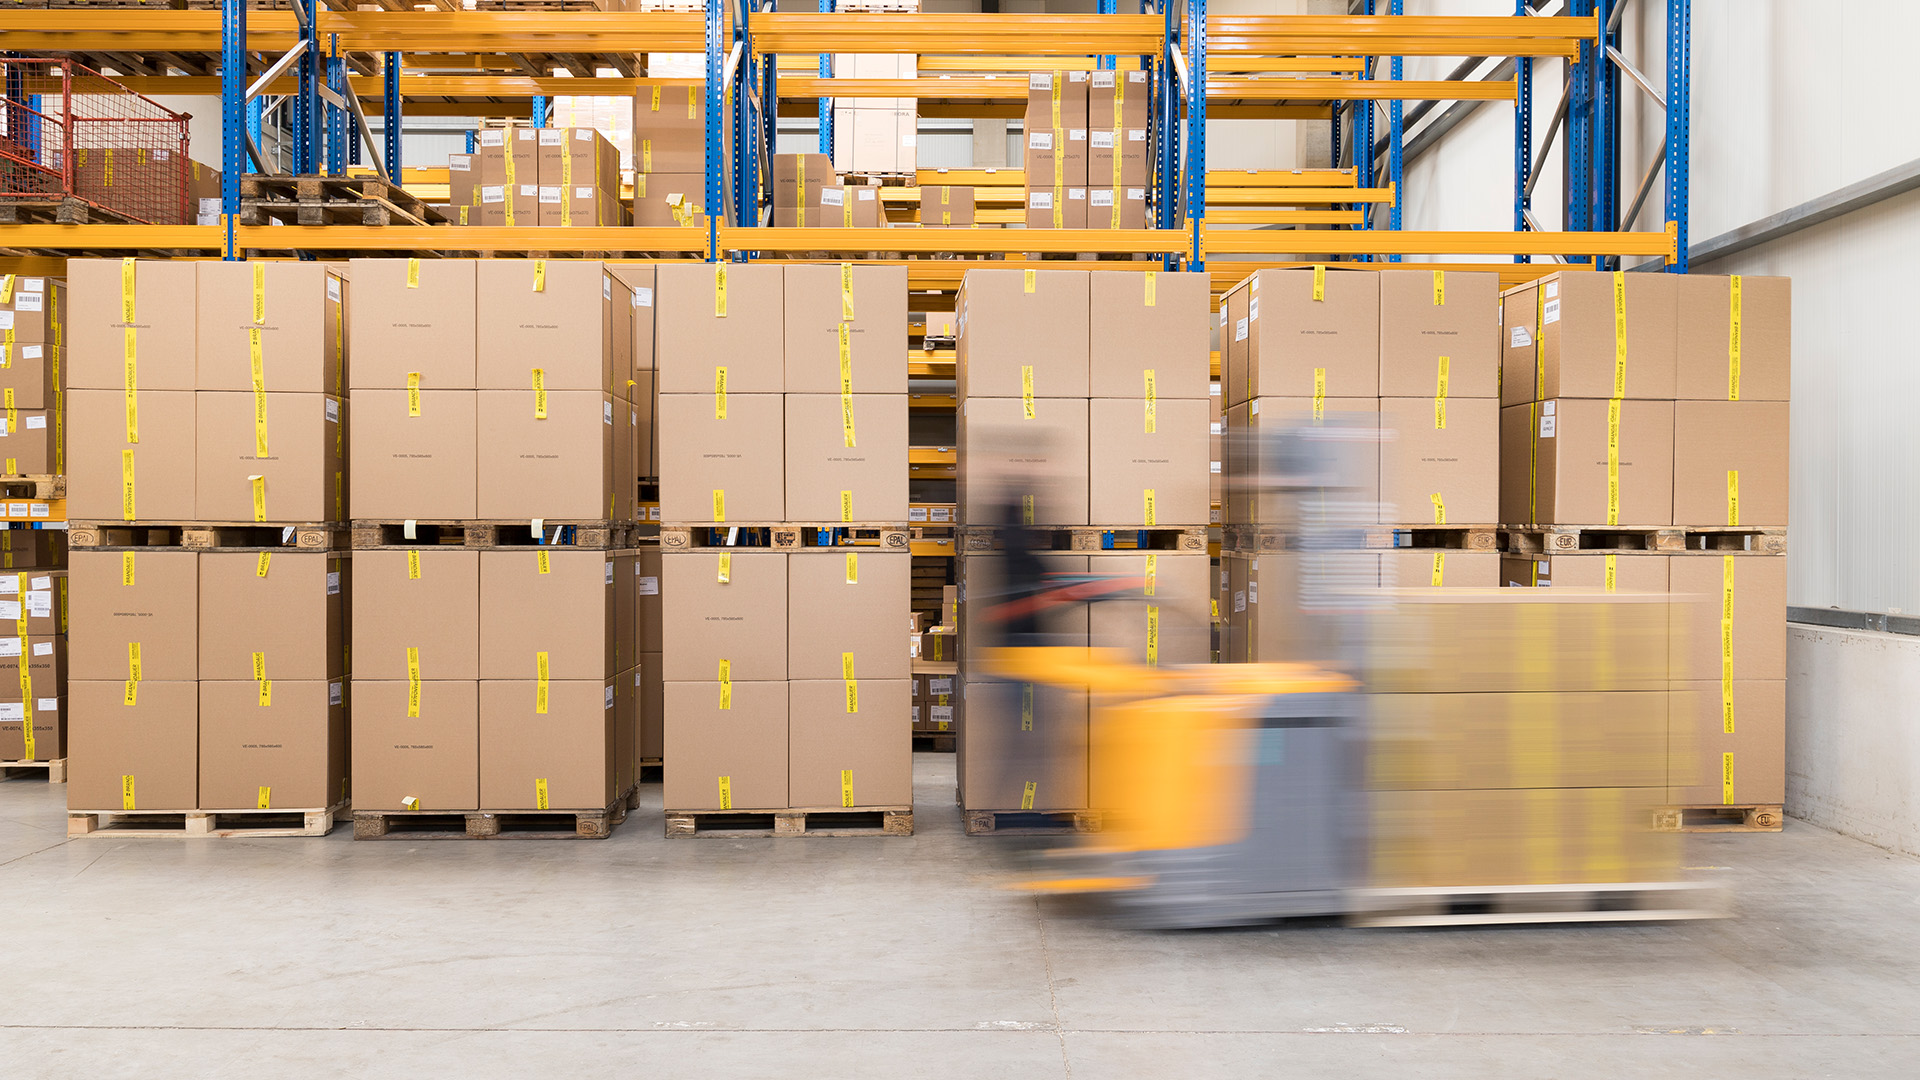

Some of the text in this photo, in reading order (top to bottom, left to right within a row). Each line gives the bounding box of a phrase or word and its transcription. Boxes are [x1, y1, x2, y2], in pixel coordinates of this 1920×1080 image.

[304, 534, 320, 544] EPAL
[667, 535, 683, 545] EPAL
[889, 535, 905, 545] EPAL
[1187, 537, 1203, 547] EPAL
[1559, 537, 1573, 547] EUR
